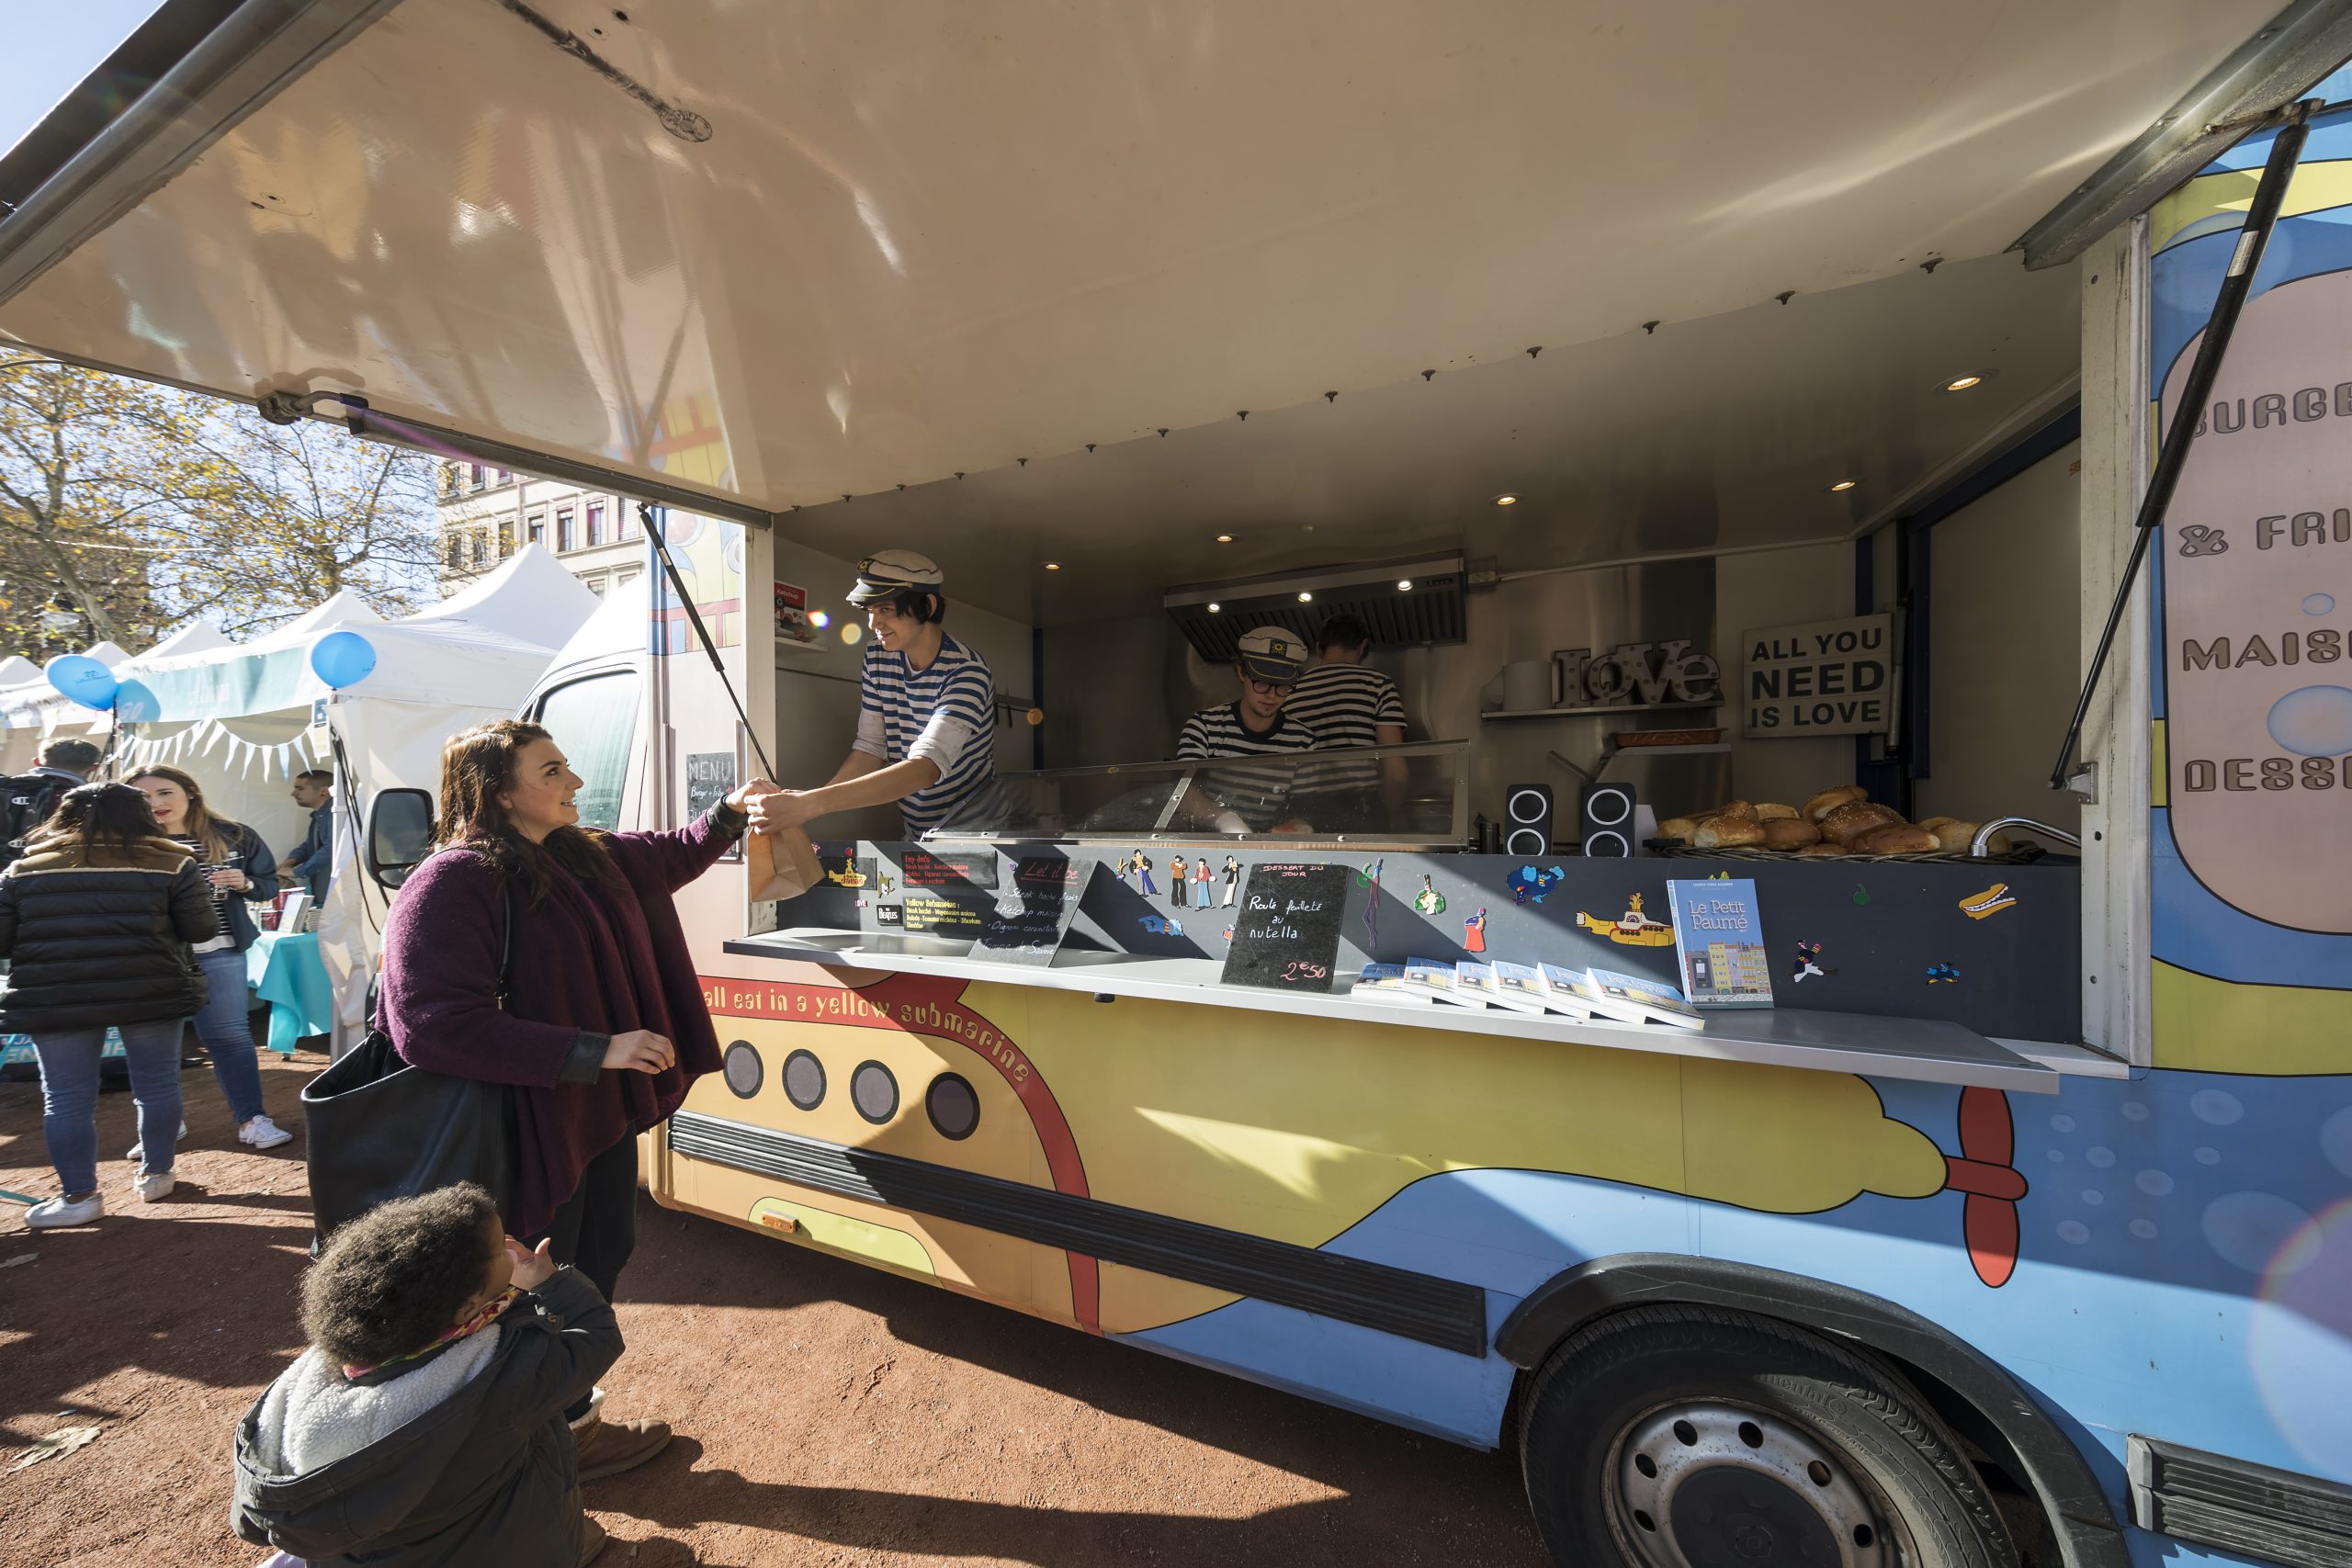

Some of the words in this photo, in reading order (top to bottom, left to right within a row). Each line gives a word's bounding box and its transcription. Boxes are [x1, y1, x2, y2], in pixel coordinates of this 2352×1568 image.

[2178, 525, 2229, 558] &
[1751, 640, 1807, 661] ALL
[1815, 627, 1882, 655] YOU
[2182, 629, 2352, 671] MAIS
[1751, 660, 1884, 700] NEED
[1751, 705, 1781, 728] IS
[1793, 700, 1882, 727] LOVE
[688, 761, 731, 781] MENU
[2185, 755, 2352, 792] DESS
[1024, 861, 1048, 877] Let
[1066, 863, 1079, 879] be
[1000, 904, 1035, 918] Ketchup
[1689, 900, 1707, 914] Le
[1711, 899, 1746, 914] Petit
[1272, 915, 1284, 924] au
[1691, 914, 1748, 930] Paumé
[1250, 925, 1297, 939] nutella
[704, 986, 726, 1009] all
[733, 991, 762, 1010] eat
[769, 988, 787, 1011] in
[797, 995, 808, 1012] a
[815, 991, 890, 1019] yellow
[900, 1002, 1029, 1083] submarine
